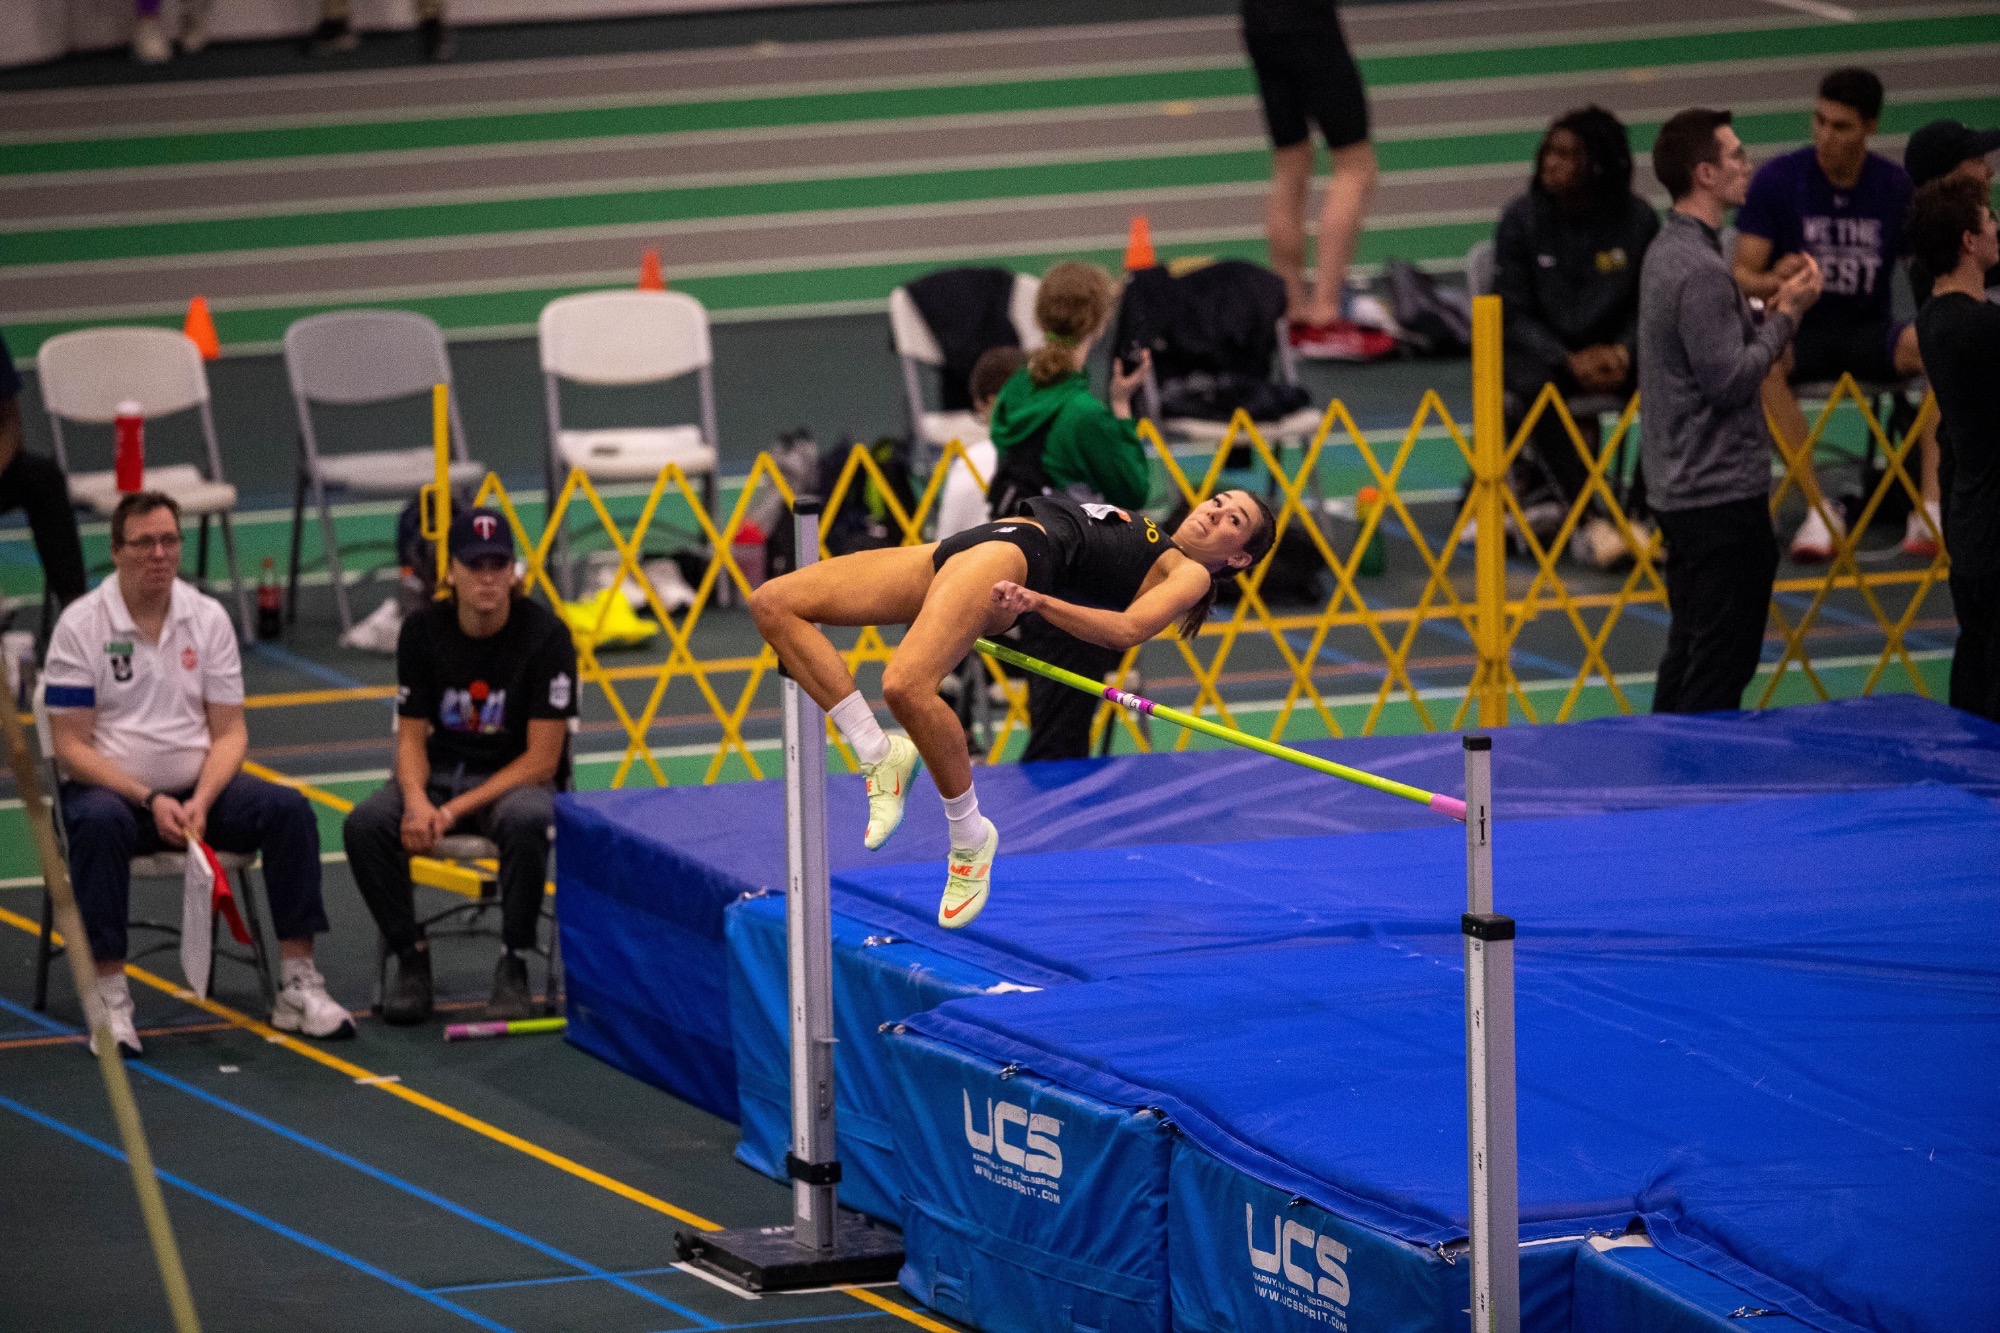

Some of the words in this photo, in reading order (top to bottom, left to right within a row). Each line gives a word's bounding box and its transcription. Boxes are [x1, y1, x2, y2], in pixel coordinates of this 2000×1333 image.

[1821, 256, 1884, 294] EST
[963, 1087, 1063, 1179] UCS
[1245, 1202, 1351, 1307] UCS
